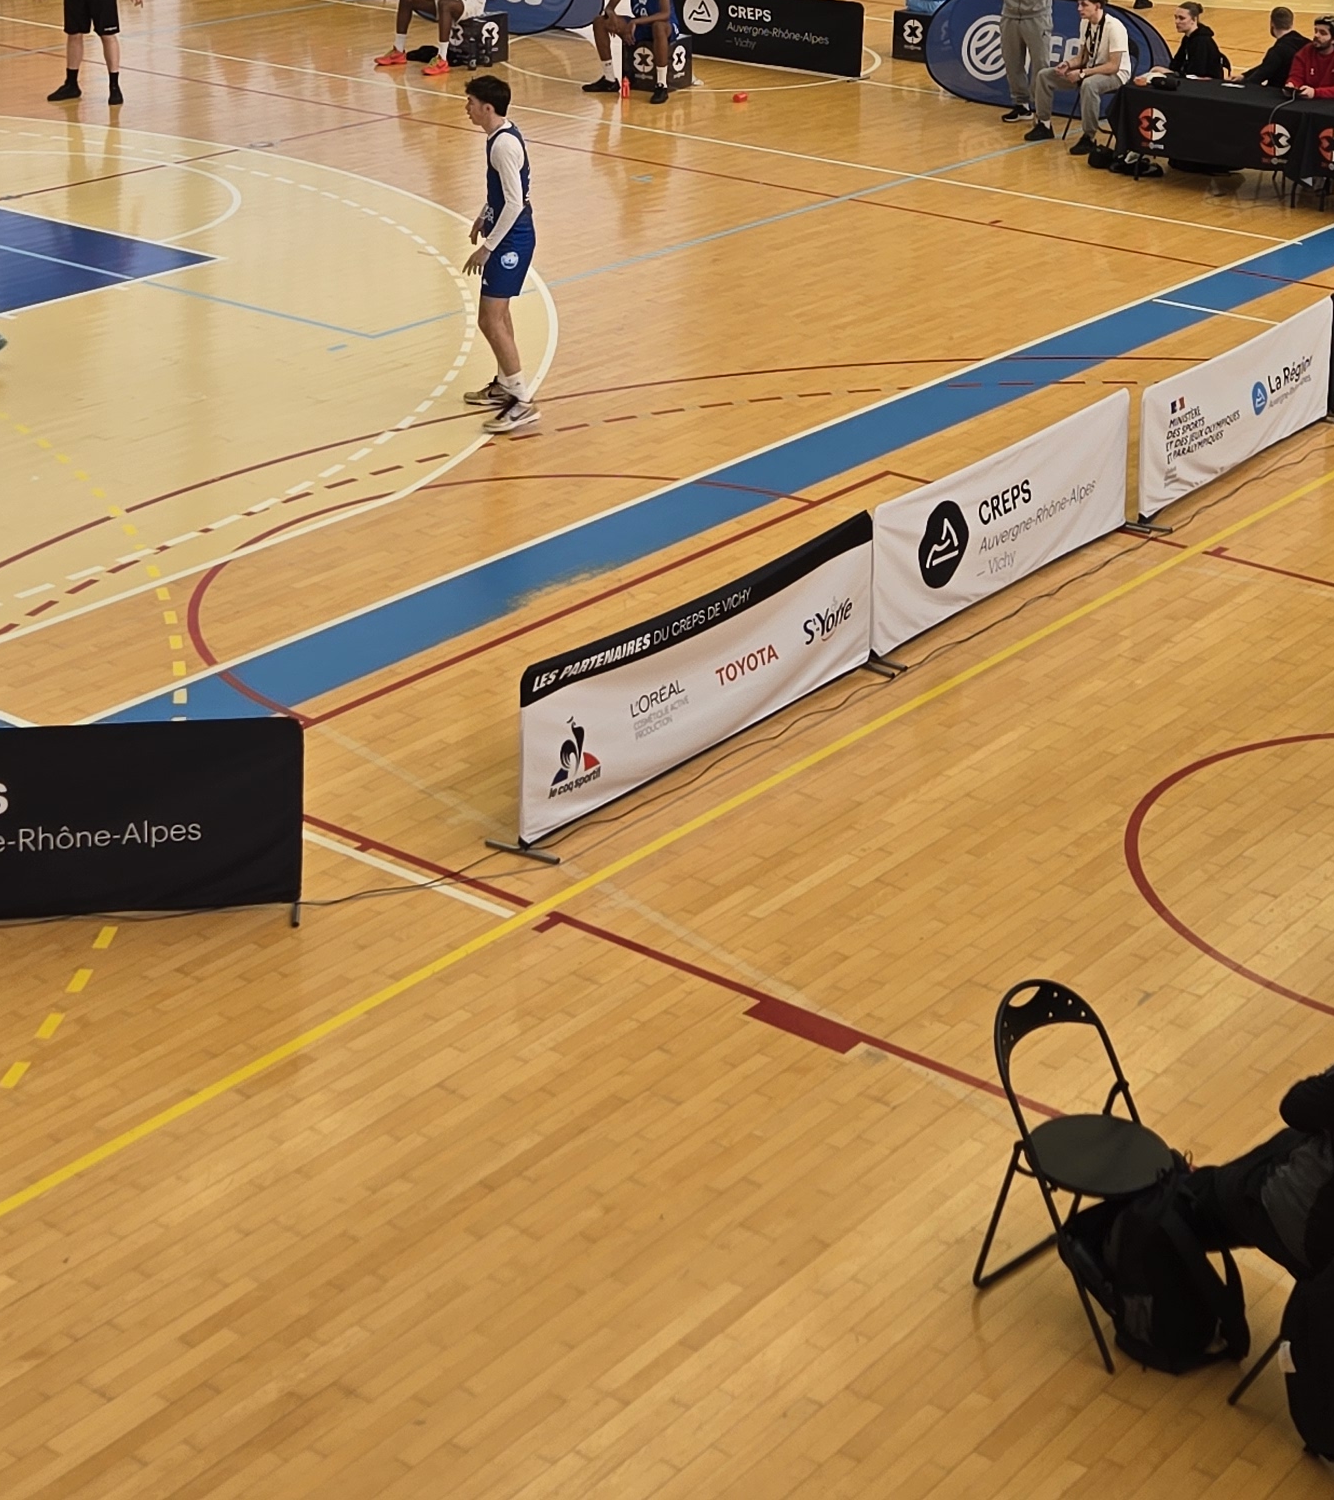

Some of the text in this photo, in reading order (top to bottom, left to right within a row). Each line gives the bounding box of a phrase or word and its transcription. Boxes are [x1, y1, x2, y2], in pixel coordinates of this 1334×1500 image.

[728, 5, 772, 23] CREPS
[726, 22, 829, 45] Auvergne-Rhône-Alpes
[1268, 375, 1282, 394] La
[1166, 417, 1205, 440] DES SPORTS
[1174, 435, 1188, 448] DES
[1188, 429, 1204, 445] JEUX
[1204, 410, 1241, 436] OLYMPIQUES
[1173, 430, 1224, 458] PARALYMPIQUES
[978, 479, 1032, 525] CREPS
[978, 480, 1097, 554] Auvergne-Rhône-Alpes
[988, 551, 1017, 575] Vichy
[532, 587, 752, 692] LES PARTENAIRES DU CREPS DE VICHY
[715, 644, 779, 686] TOYOTA
[558, 781, 574, 795] coq
